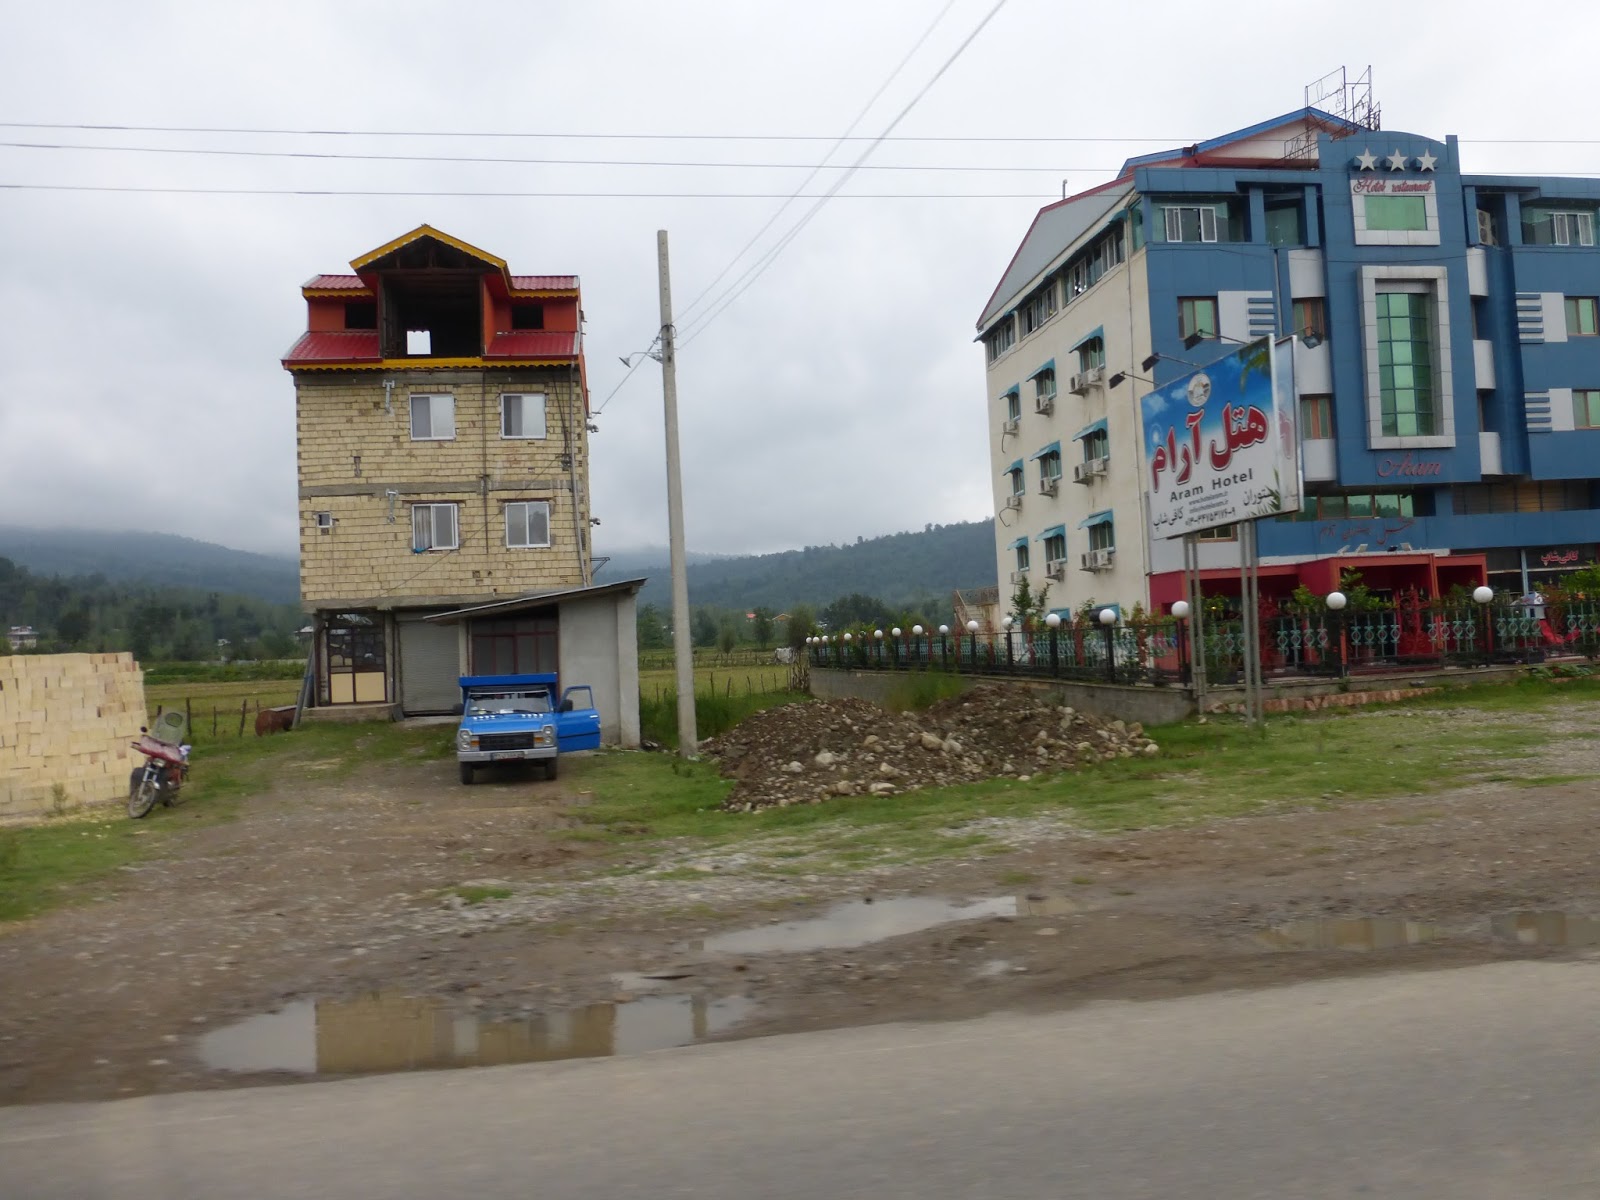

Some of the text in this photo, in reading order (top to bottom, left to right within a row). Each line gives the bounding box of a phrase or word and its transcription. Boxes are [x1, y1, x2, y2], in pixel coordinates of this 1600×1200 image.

[1152, 408, 1204, 493] آرام
[1210, 402, 1268, 471] هتل
[1169, 485, 1204, 503] Aram
[1211, 467, 1254, 490] Hotel
